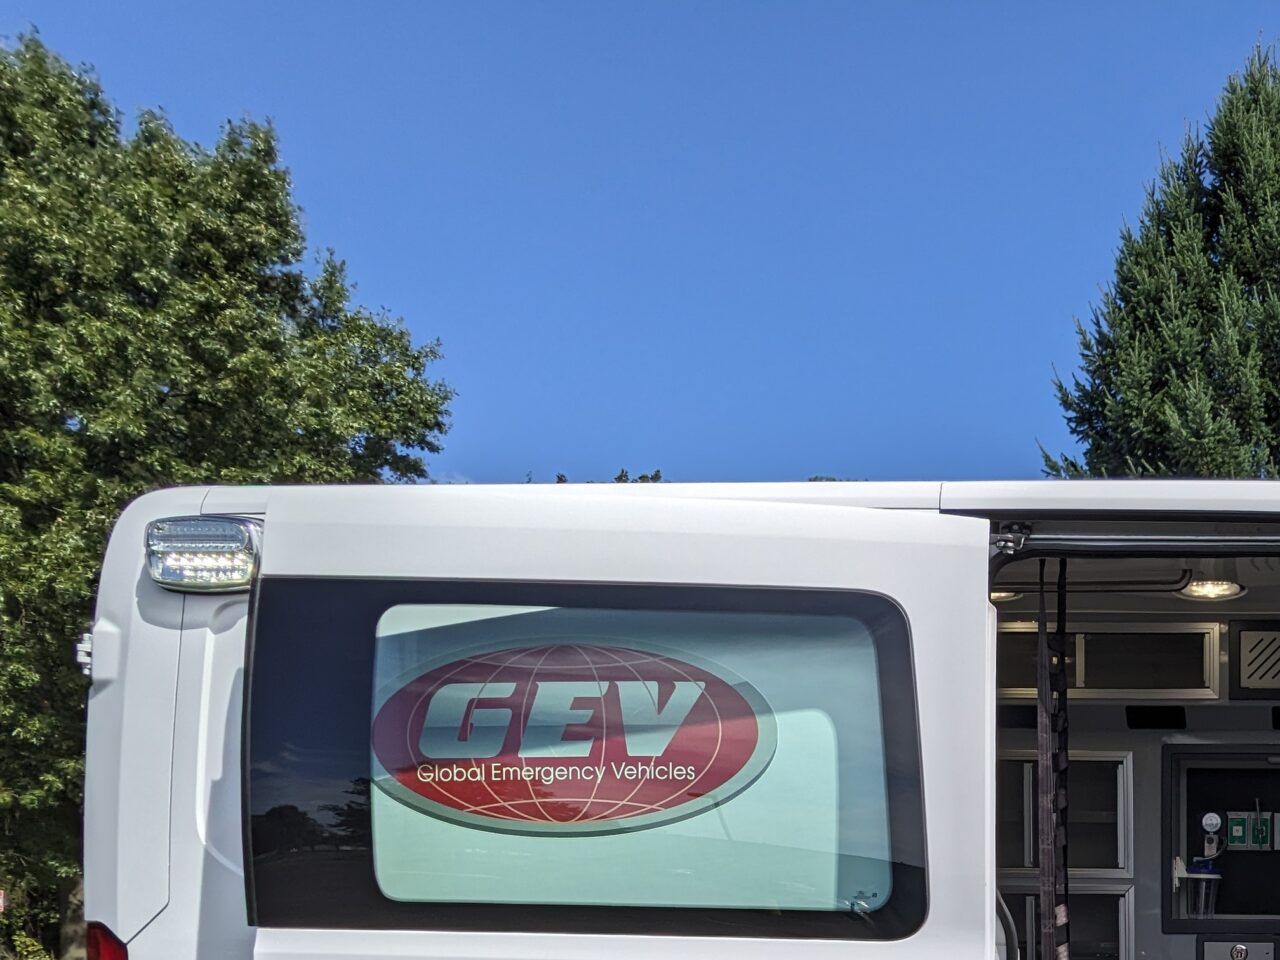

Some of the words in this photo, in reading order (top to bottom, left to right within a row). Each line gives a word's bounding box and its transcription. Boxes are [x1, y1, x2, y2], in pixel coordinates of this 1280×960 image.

[418, 680, 706, 758] GEV
[416, 763, 486, 784] Global
[491, 762, 606, 784] Emergency
[611, 761, 696, 782] Vehicles
